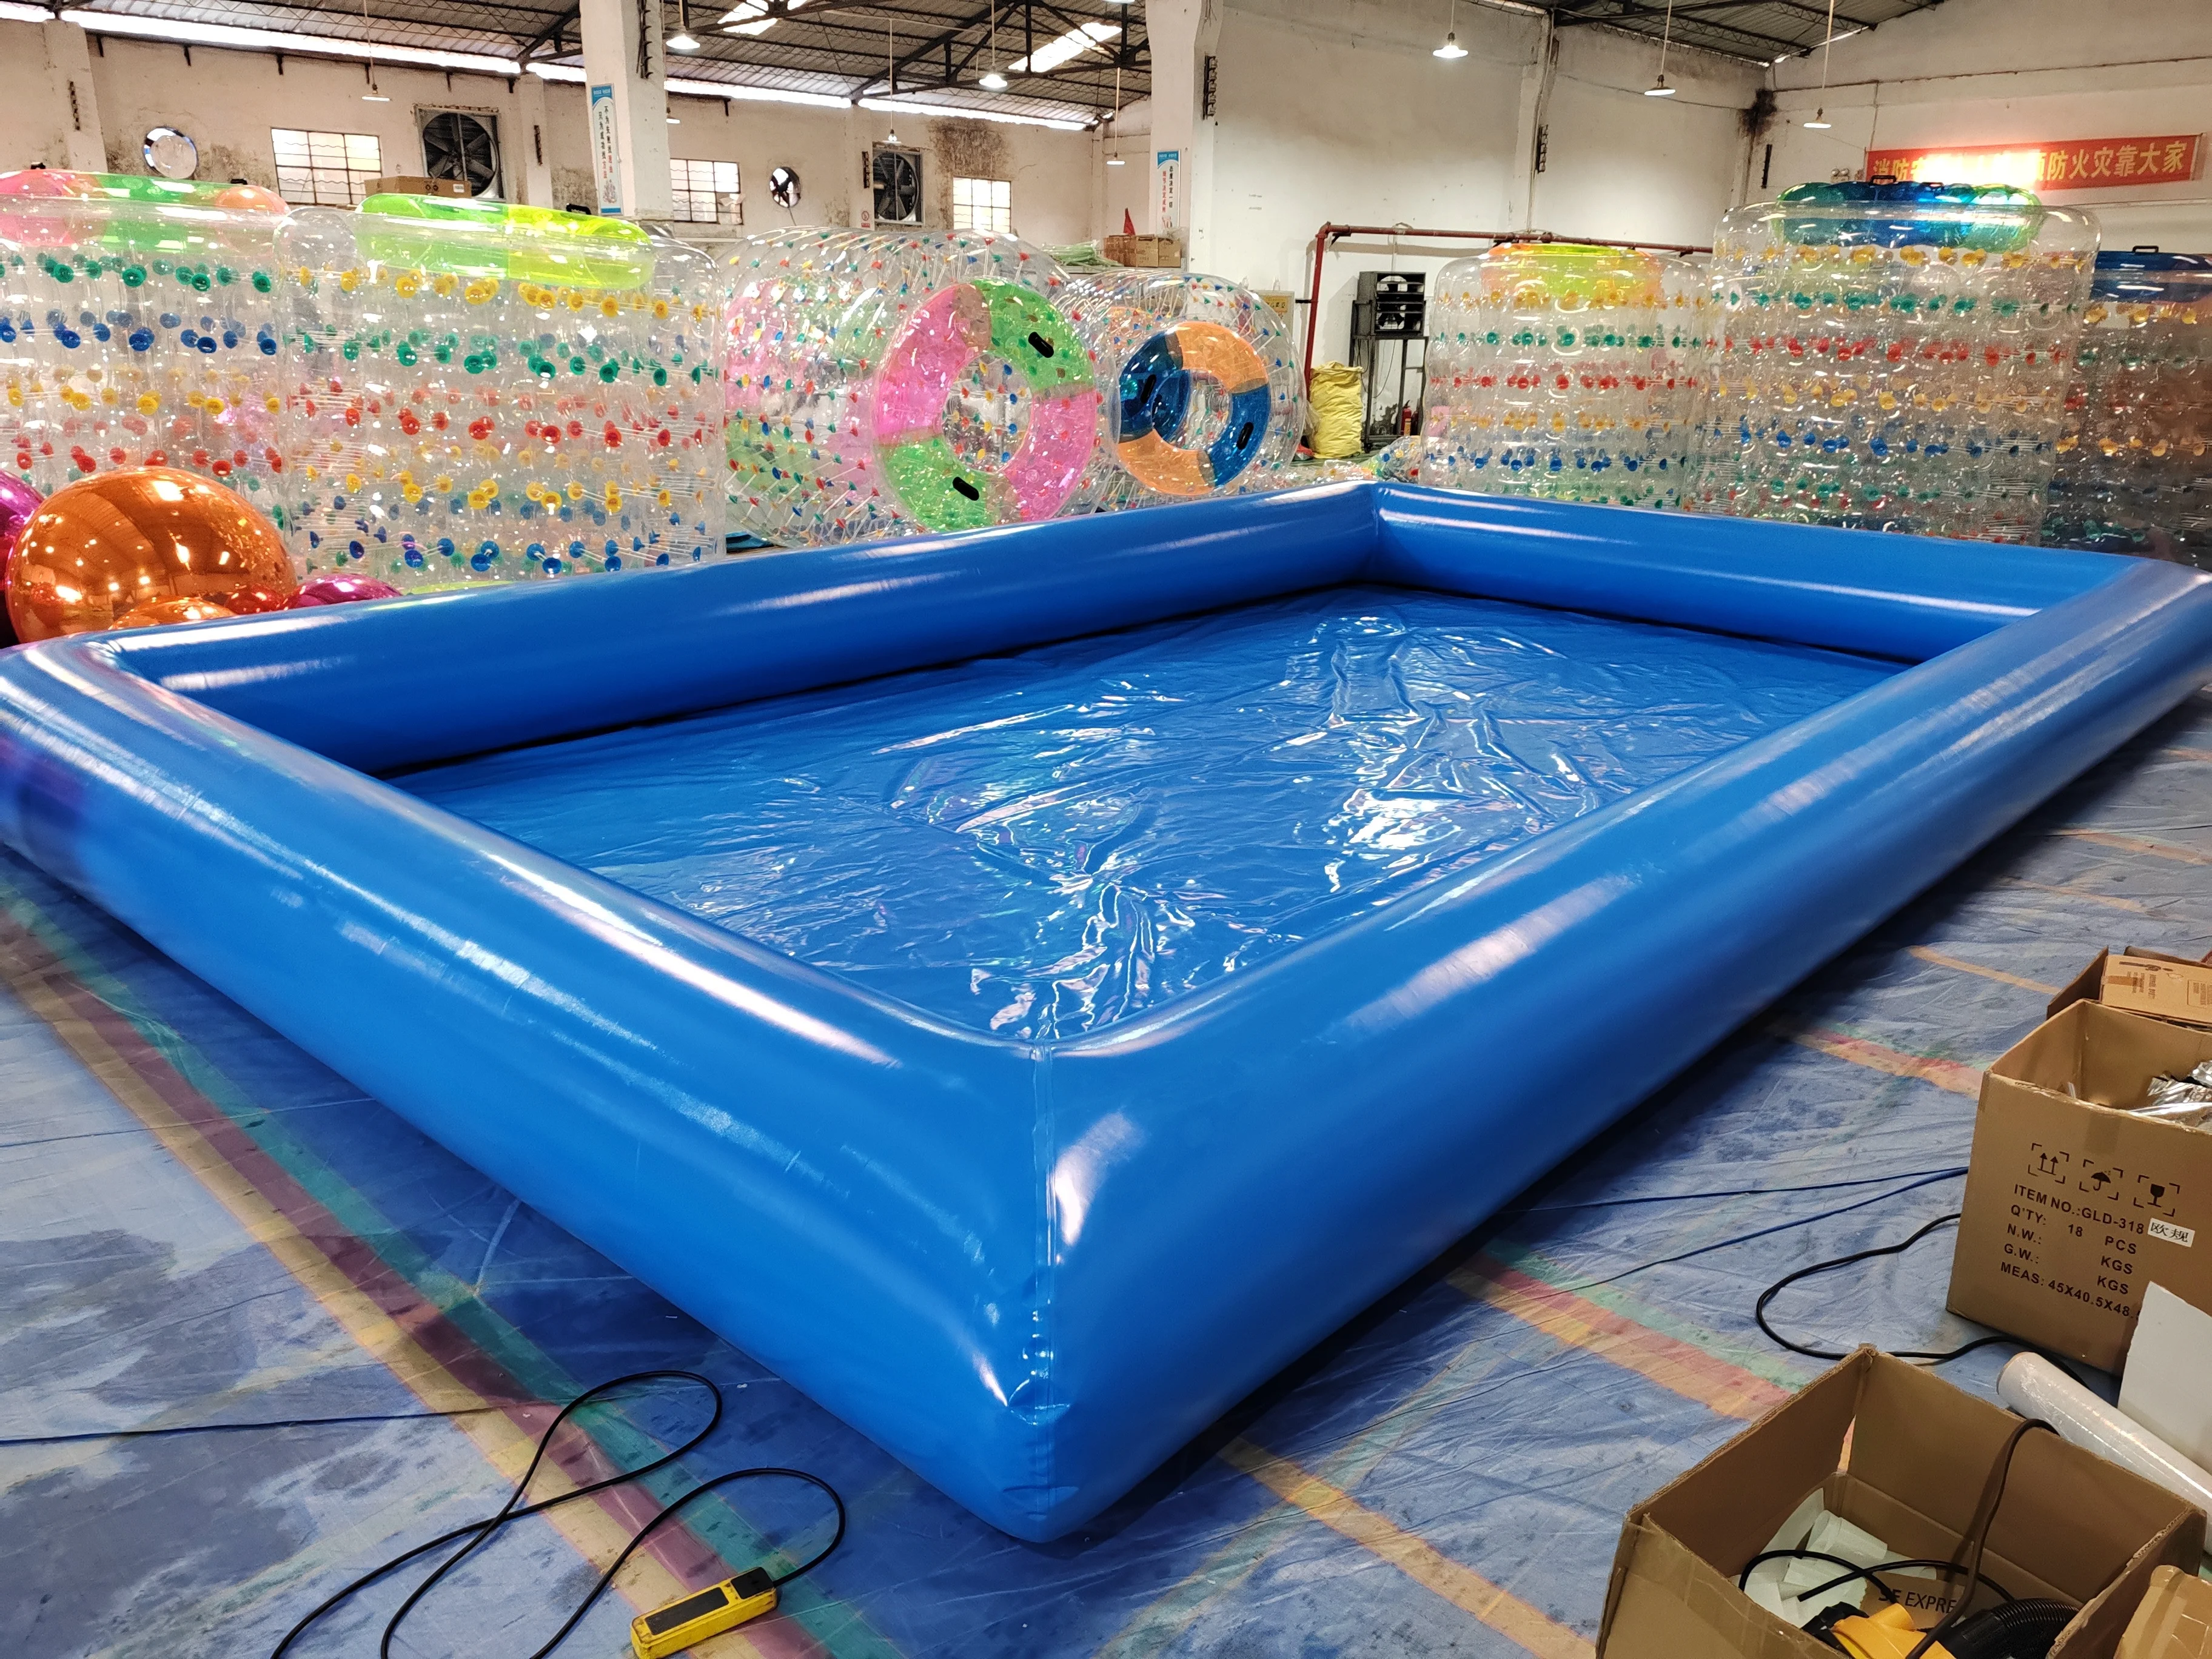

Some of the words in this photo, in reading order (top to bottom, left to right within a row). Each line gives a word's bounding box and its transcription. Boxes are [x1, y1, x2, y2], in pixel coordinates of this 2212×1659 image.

[2014, 1184, 2047, 1205] ITEM
[2011, 1205, 2046, 1225] Q'TY:
[2068, 1224, 2083, 1237] 18
[2105, 1236, 2137, 1254] PCS
[2151, 1222, 2189, 1242] 欧规
[2008, 1223, 2042, 1244] N.W.:
[2100, 1256, 2133, 1274] KGS
[2001, 1261, 2045, 1285] MEAS:
[2004, 1244, 2039, 1264] G.W.:
[2097, 1276, 2129, 1295] KGS
